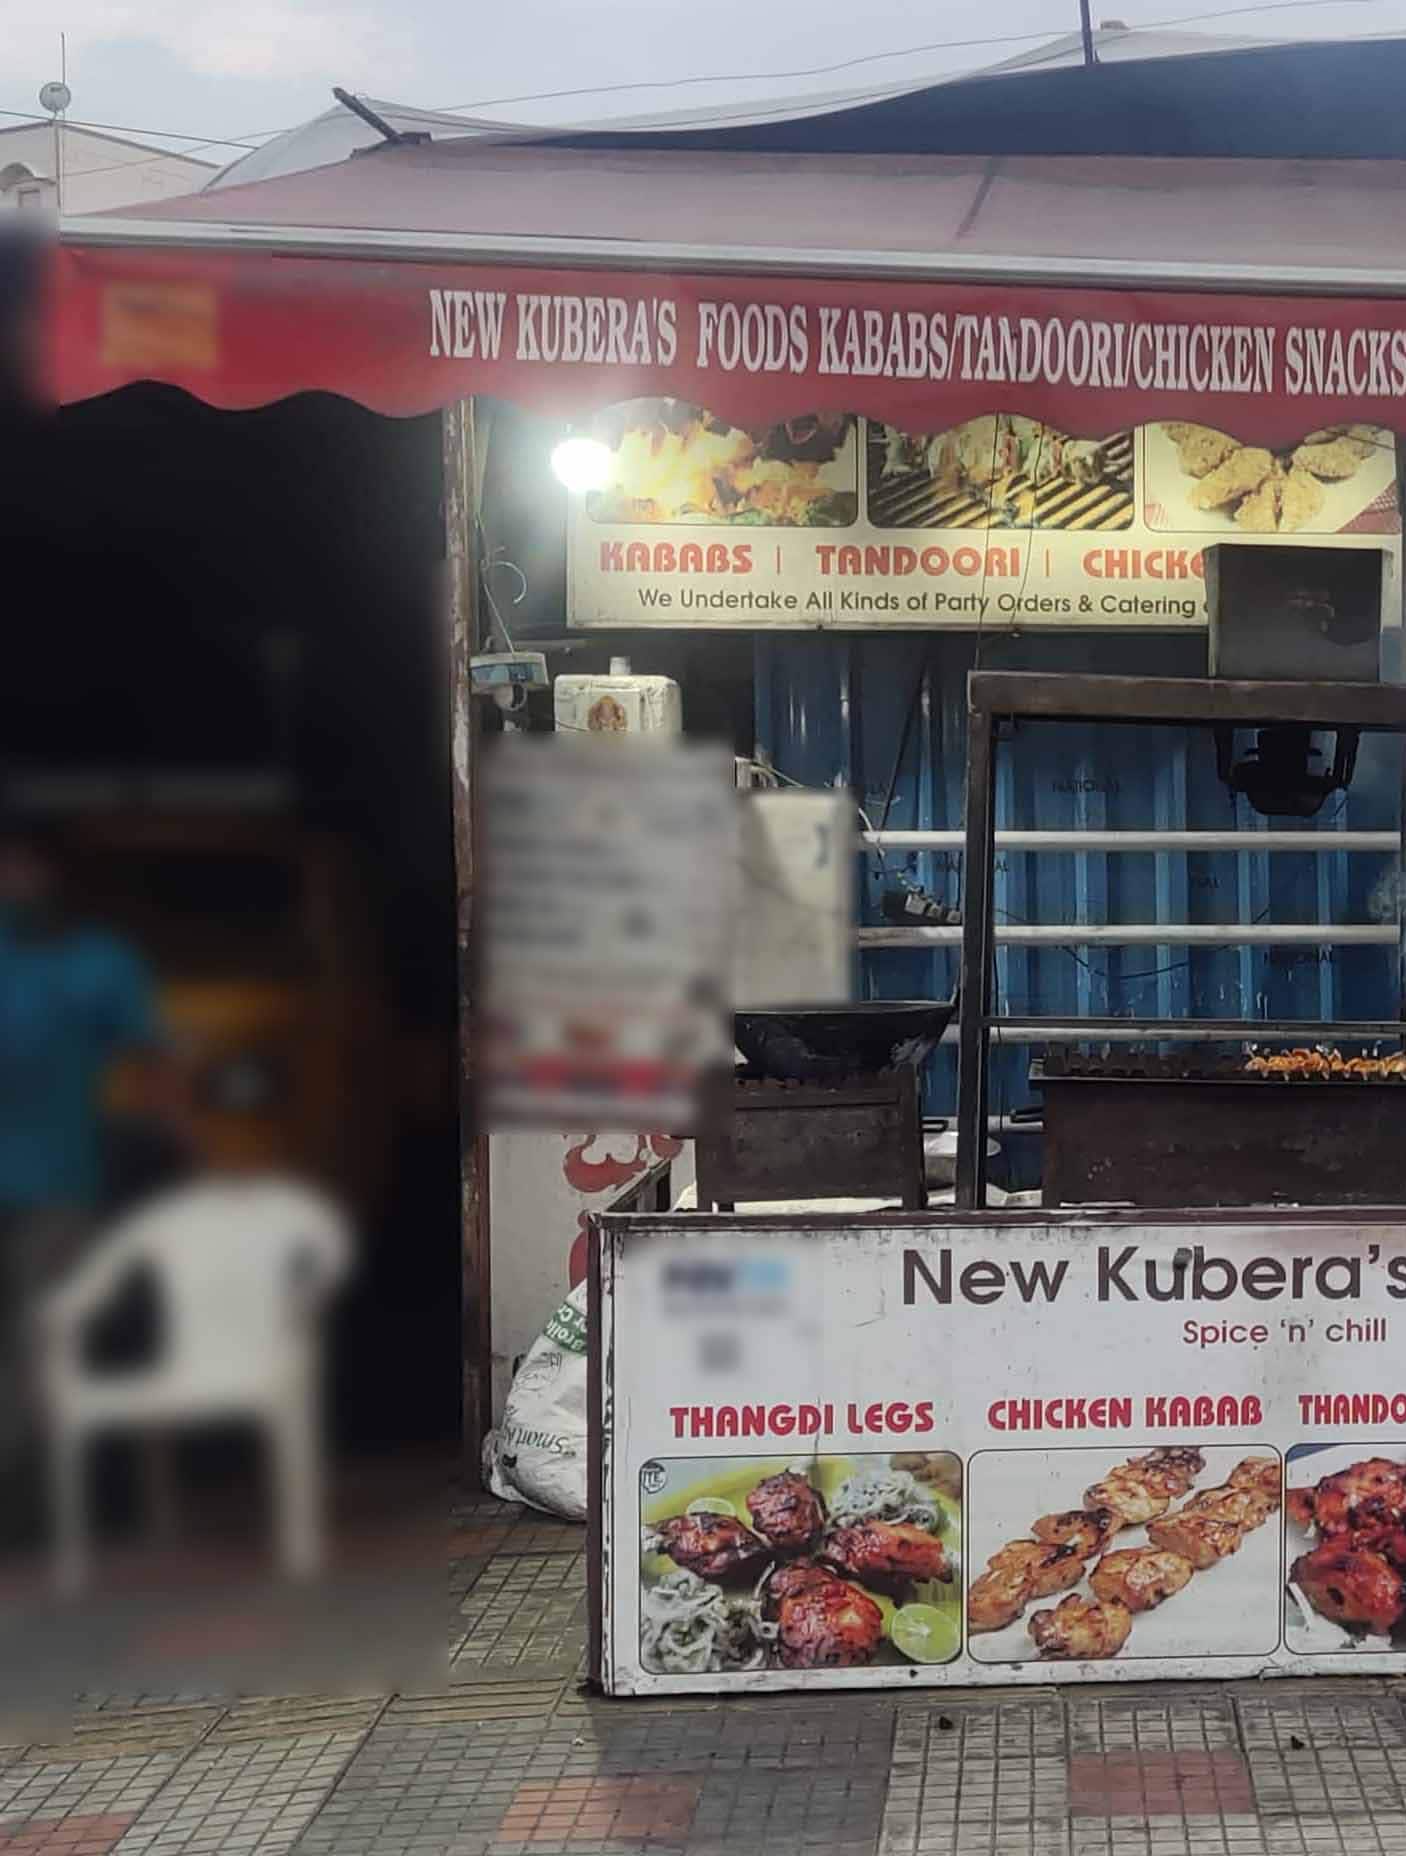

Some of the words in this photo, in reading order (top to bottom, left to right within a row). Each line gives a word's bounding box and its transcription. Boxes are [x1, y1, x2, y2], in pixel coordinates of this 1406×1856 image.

[429, 289, 506, 360] NEW
[515, 295, 677, 367] KUBERA'S
[697, 303, 808, 373] FOODS
[818, 307, 1276, 393] KABABS/TANDOORI/CHICKEN
[600, 541, 753, 574] KABABS
[815, 544, 1019, 577] TANDOORI
[1083, 548, 1205, 580] CHICKE
[638, 588, 672, 607] We
[680, 589, 798, 610] Undertake
[806, 590, 832, 609] All
[840, 591, 899, 611] Kinds
[907, 592, 928, 611] of
[935, 593, 990, 616] Party
[998, 593, 1071, 613] Orders
[1078, 594, 1093, 613] &
[1100, 594, 1196, 619] Catering
[903, 1248, 1070, 1304] New
[1183, 1319, 1269, 1348] Spice
[1325, 1318, 1387, 1343] chill
[670, 1403, 834, 1438] THANGDI
[848, 1401, 934, 1434] LEGS
[987, 1397, 1132, 1432] CHICKEN
[1146, 1394, 1263, 1428] KABAB
